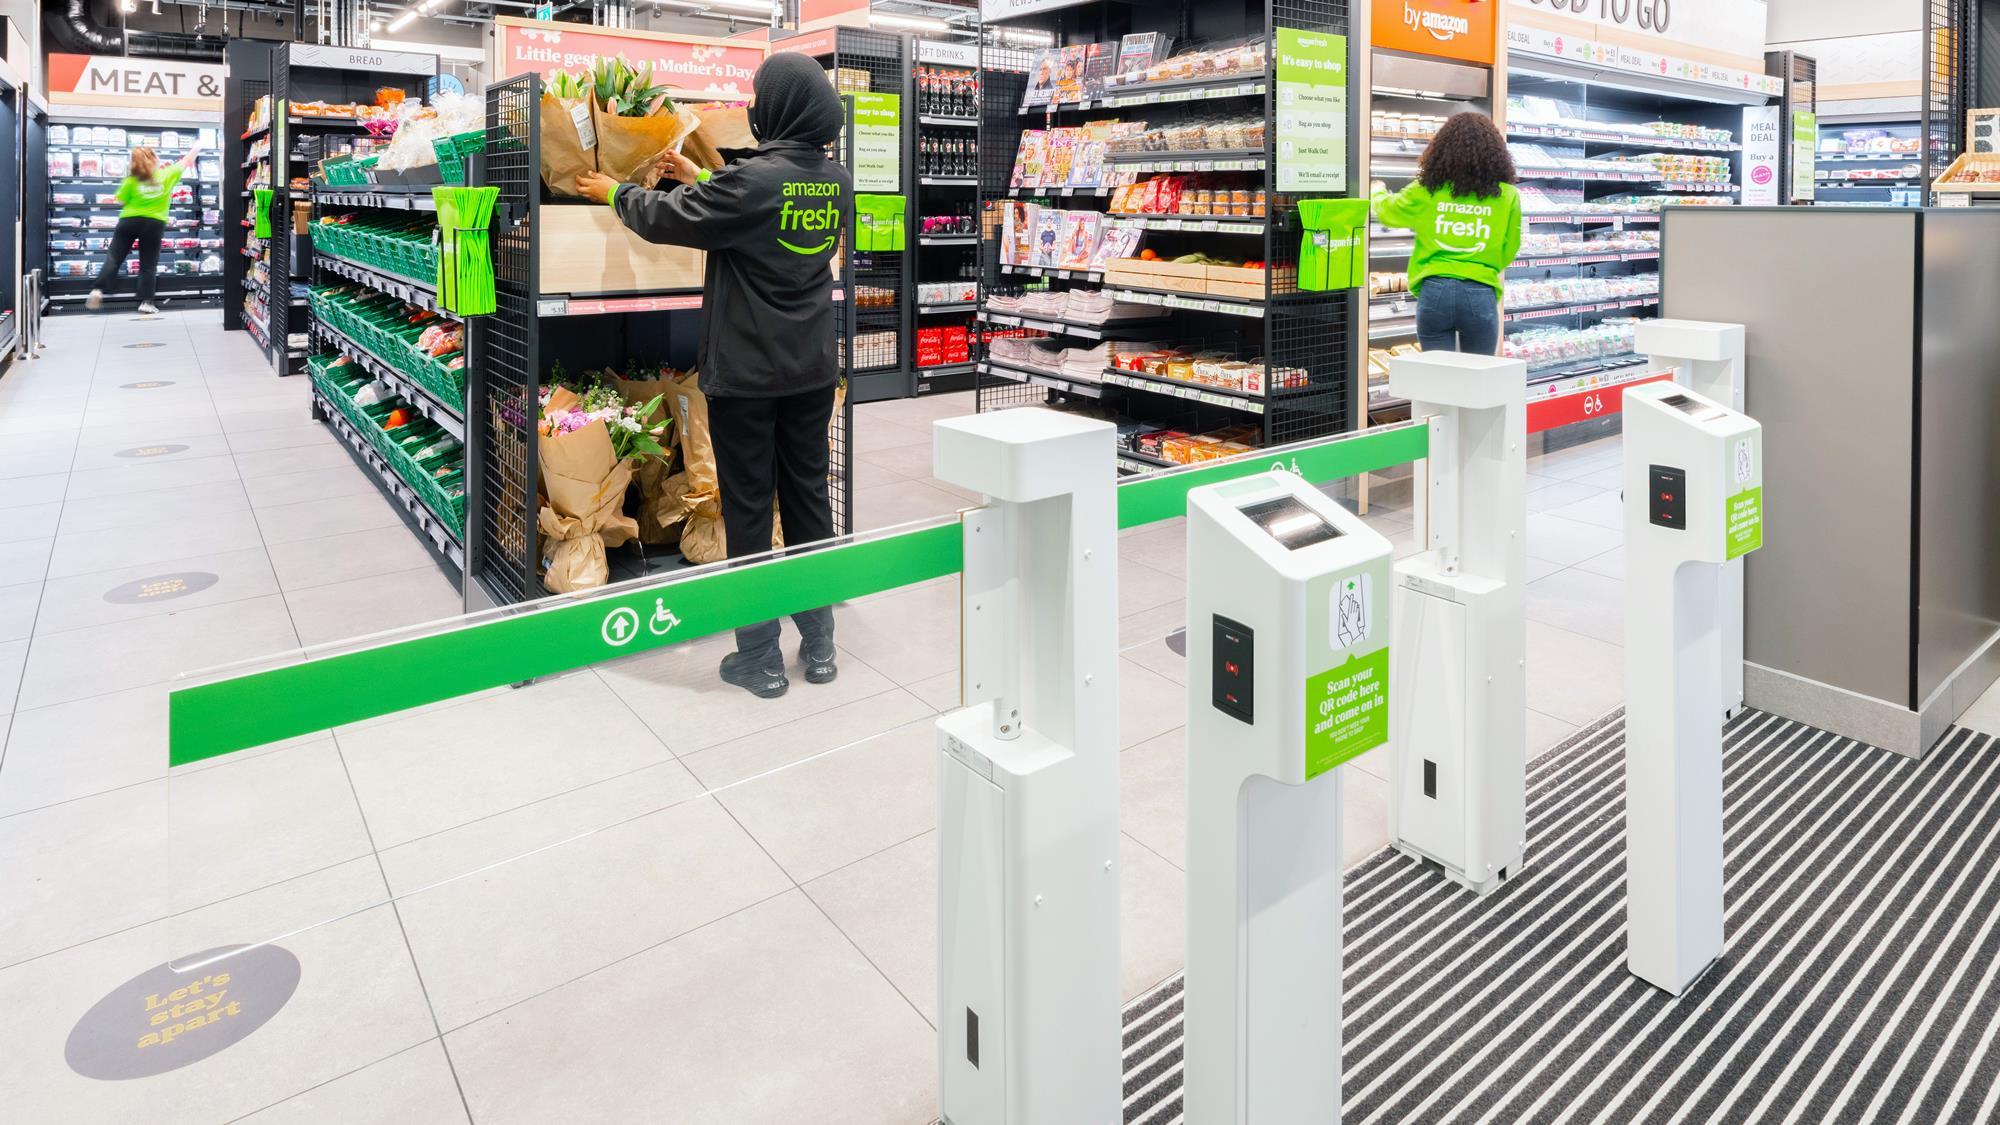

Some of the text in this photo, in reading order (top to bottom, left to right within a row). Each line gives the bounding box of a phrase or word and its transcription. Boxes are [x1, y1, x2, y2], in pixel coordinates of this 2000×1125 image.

[1404, 1, 1468, 34] by amazon
[1636, 0, 1671, 33] GO
[1507, 30, 1531, 44] EAL DEAL
[349, 55, 382, 66] BREAD
[515, 46, 561, 62] Little
[659, 58, 723, 77] Mother's
[725, 64, 756, 81] Day.
[919, 47, 965, 60] OFT DRINKS
[1282, 54, 1342, 73] It's easy to shop
[91, 68, 221, 97] MEAT &
[1298, 93, 1313, 101] Choose
[1314, 94, 1324, 102] what
[856, 109, 871, 117] easy
[880, 109, 896, 118] shop
[1750, 133, 1775, 142] DEAL
[1751, 122, 1776, 131] MEAL
[1750, 154, 1767, 162] Buy
[782, 182, 840, 196] amazon
[780, 200, 840, 231] fresh
[1436, 201, 1492, 216] amazon
[1434, 214, 1491, 239] fresh
[1327, 667, 1374, 695] Scan your
[1320, 681, 1380, 716] QR code here
[1314, 693, 1384, 734] and come on in
[144, 973, 231, 1012] Let's
[150, 989, 227, 1026] stay
[137, 1001, 240, 1048] apart
